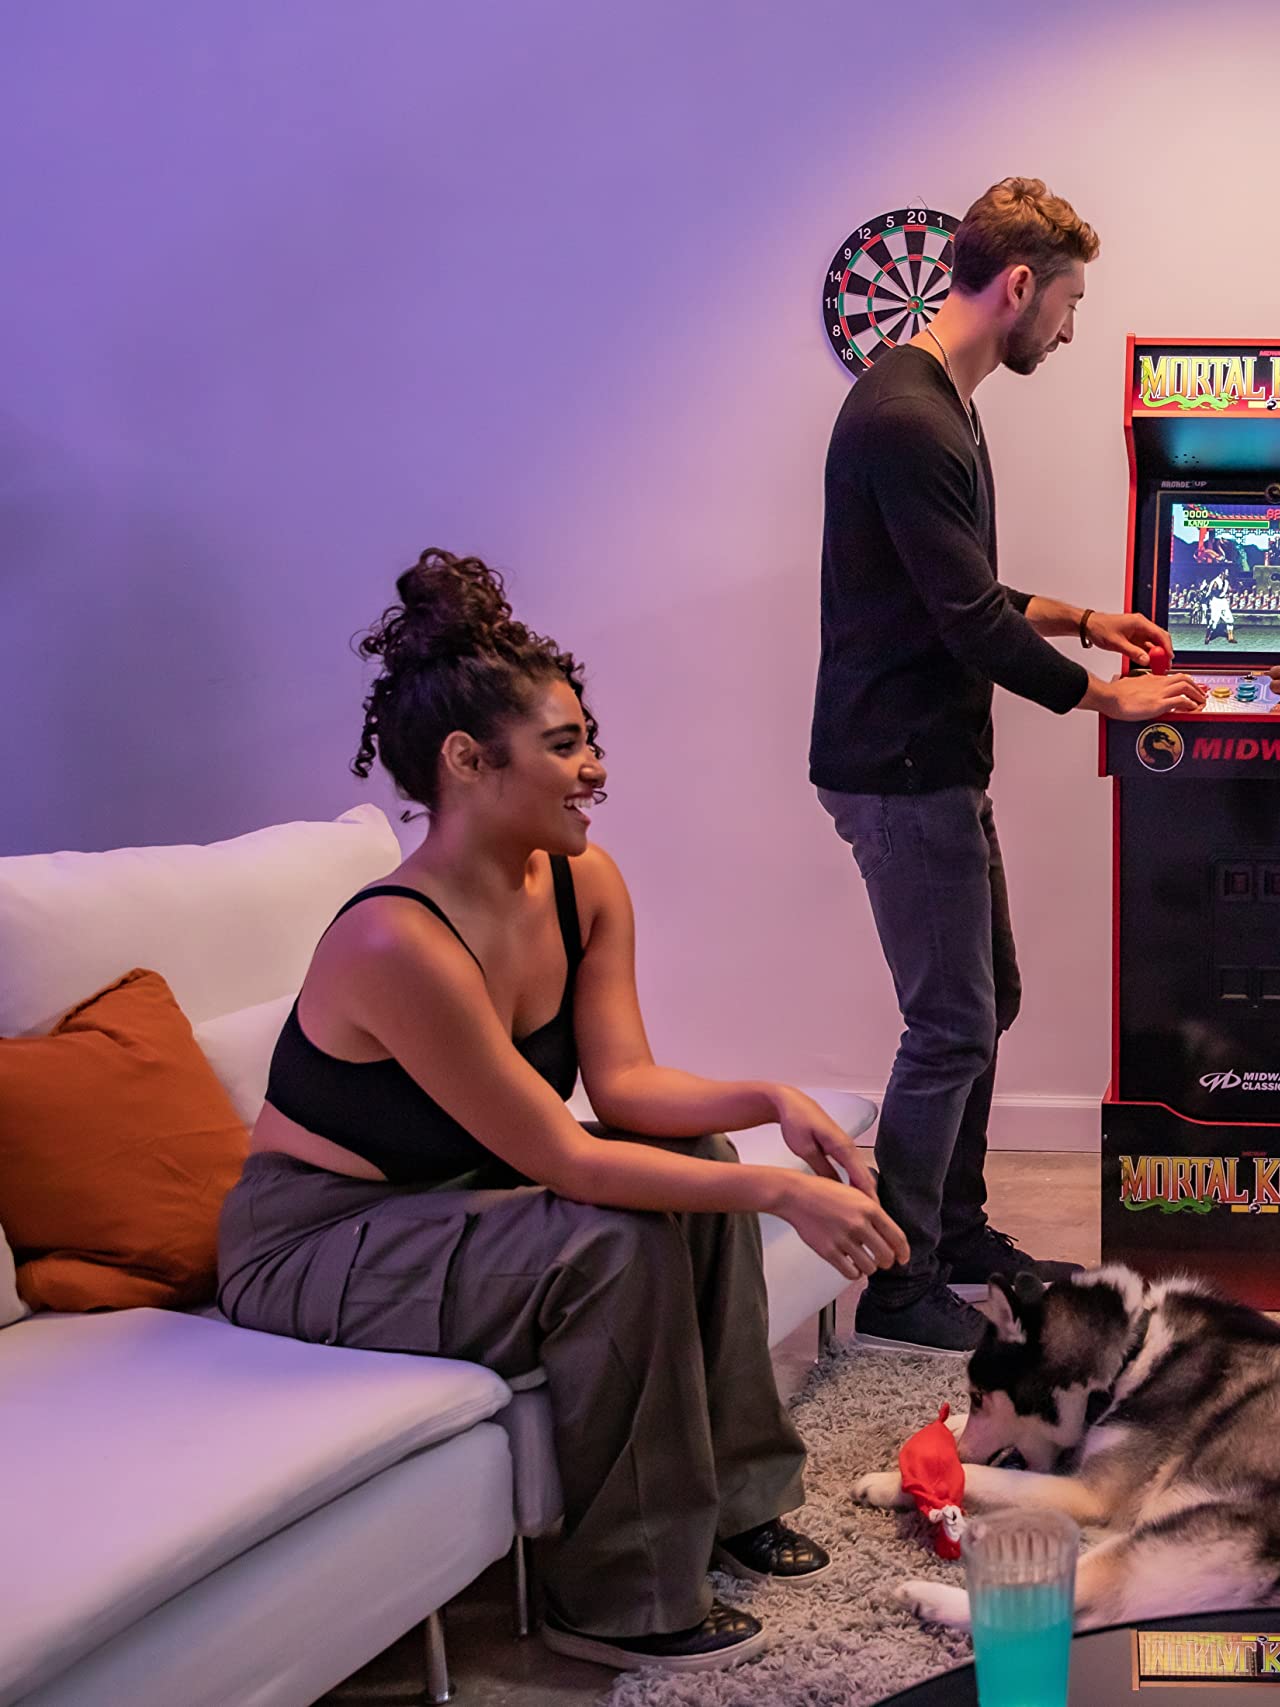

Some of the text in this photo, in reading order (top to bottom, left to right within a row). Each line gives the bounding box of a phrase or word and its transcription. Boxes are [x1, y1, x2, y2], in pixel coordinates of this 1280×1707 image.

[886, 216, 895, 228] 5
[907, 211, 927, 224] 20
[937, 216, 943, 227] 1
[858, 228, 871, 240] 12
[844, 248, 852, 259] 9
[829, 271, 843, 283] 14
[825, 297, 838, 309] 11
[832, 325, 841, 337] 8
[841, 348, 854, 360] 16
[1138, 355, 1265, 400] MORTAL
[1119, 1156, 1249, 1204] MORTAL
